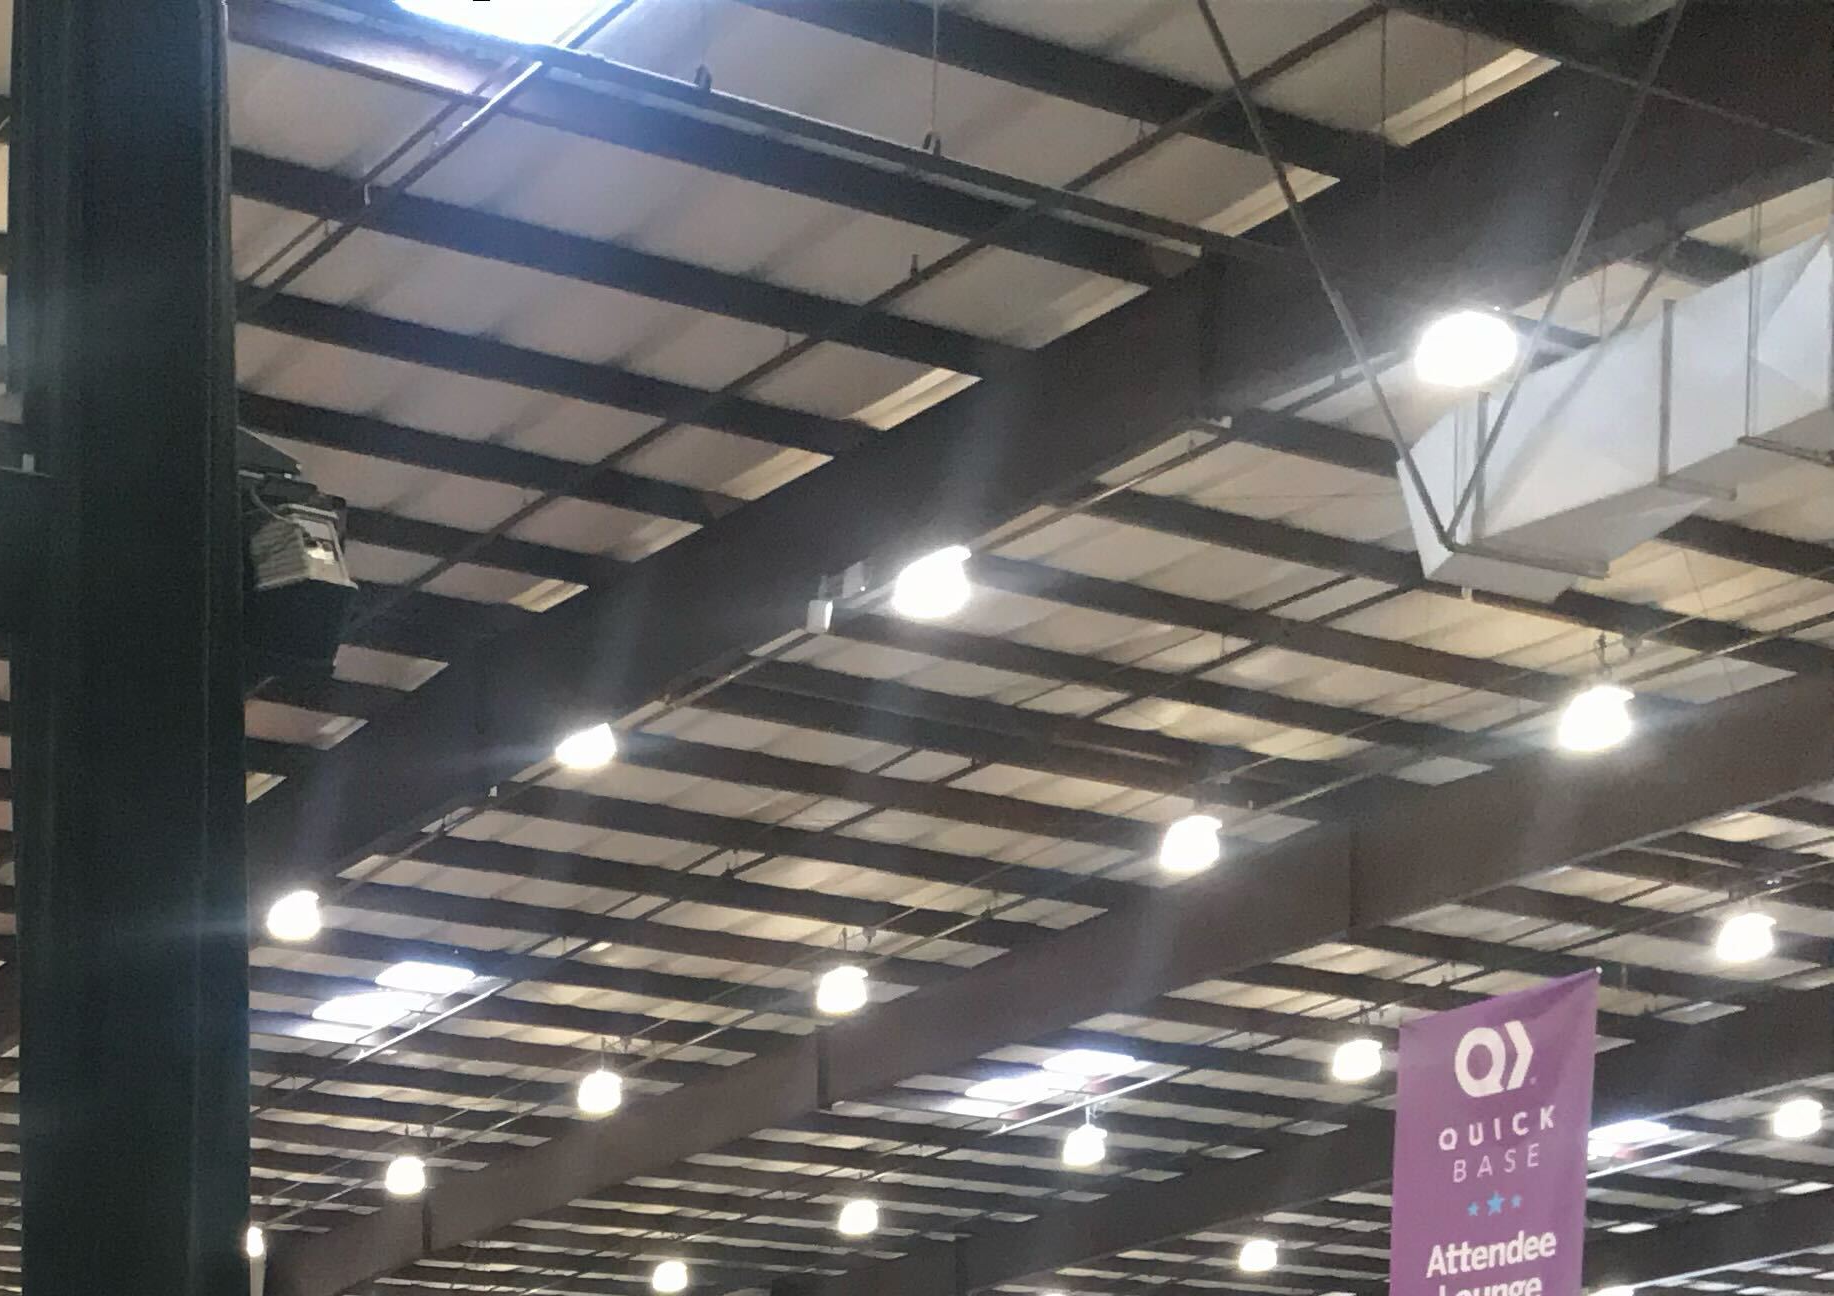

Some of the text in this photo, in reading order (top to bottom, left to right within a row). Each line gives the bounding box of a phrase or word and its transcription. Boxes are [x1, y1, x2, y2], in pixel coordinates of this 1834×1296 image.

[1438, 1105, 1555, 1151] QUICK
[1452, 1143, 1541, 1183] BASE
[1426, 1230, 1557, 1278] Attendee
